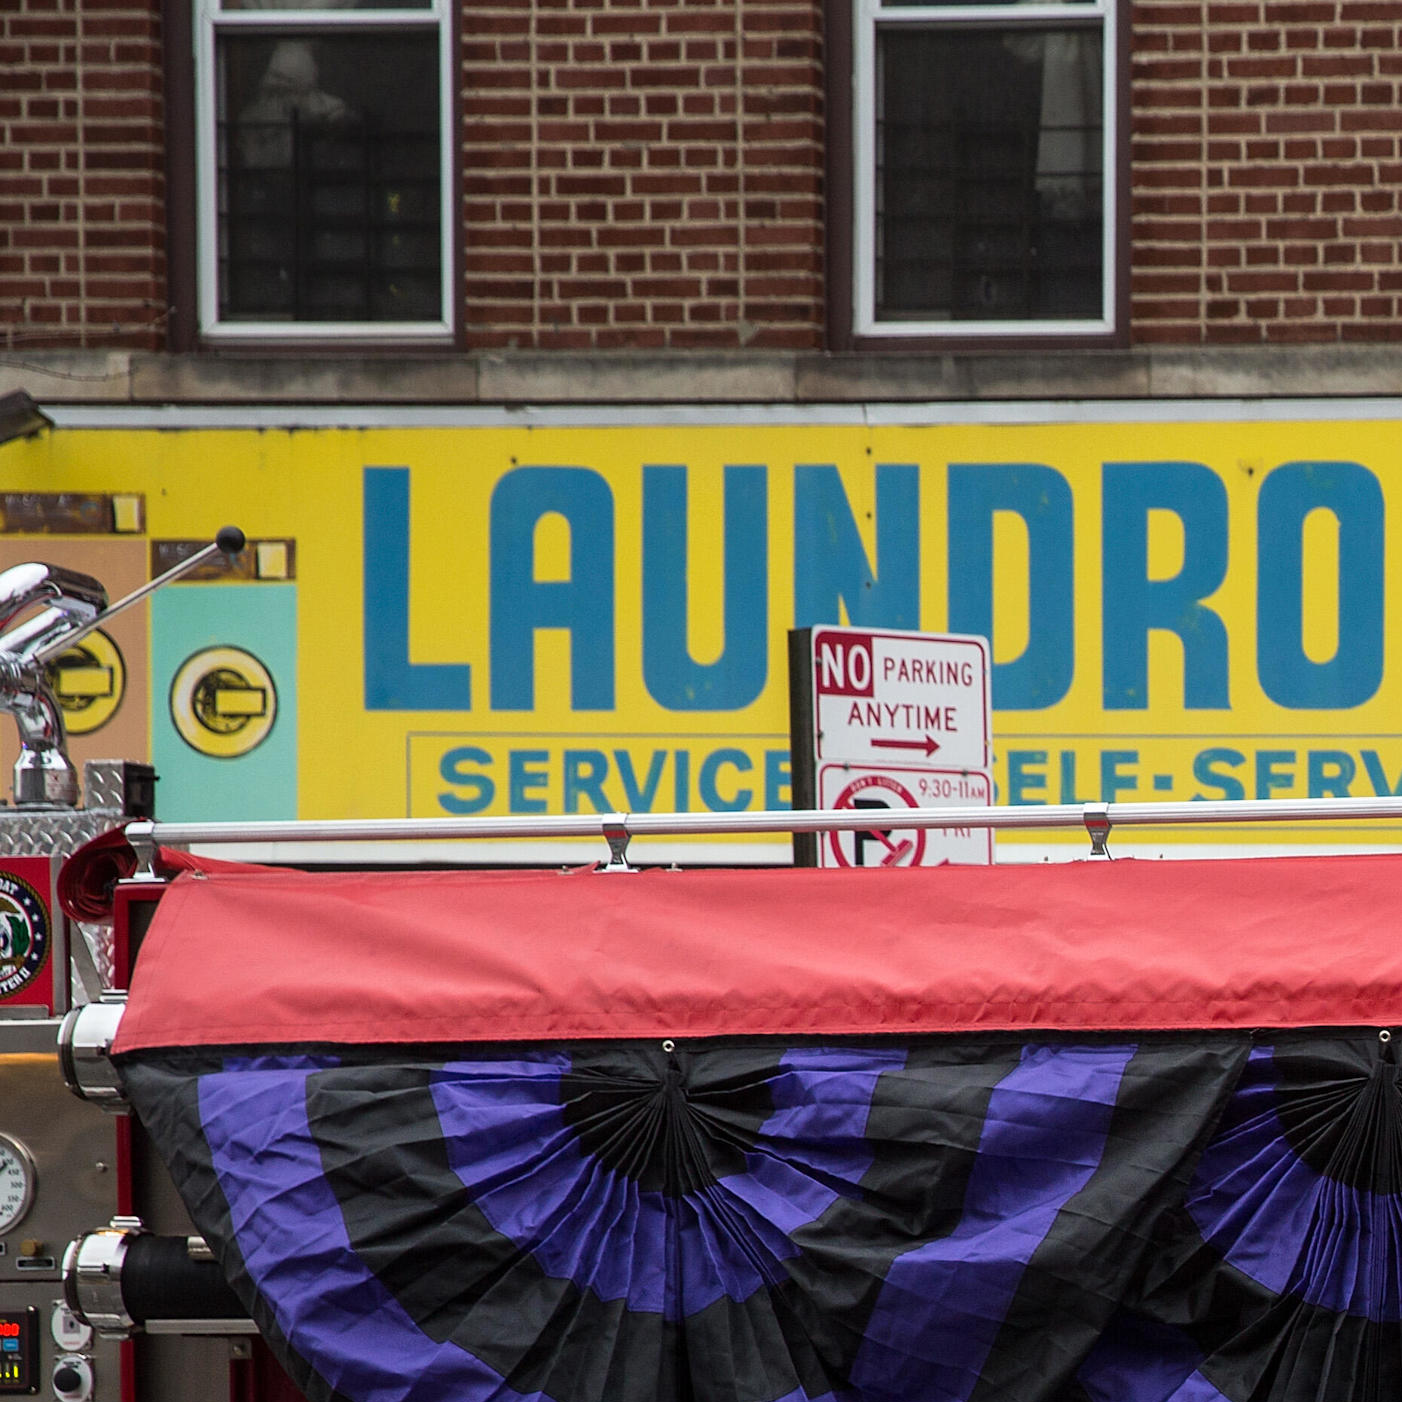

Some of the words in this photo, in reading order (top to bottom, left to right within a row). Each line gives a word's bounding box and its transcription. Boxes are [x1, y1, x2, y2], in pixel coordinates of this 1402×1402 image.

[821, 643, 872, 691] NO
[883, 657, 973, 687] PARKING
[848, 701, 958, 732] ANYTIME
[437, 745, 792, 815] SERVICE
